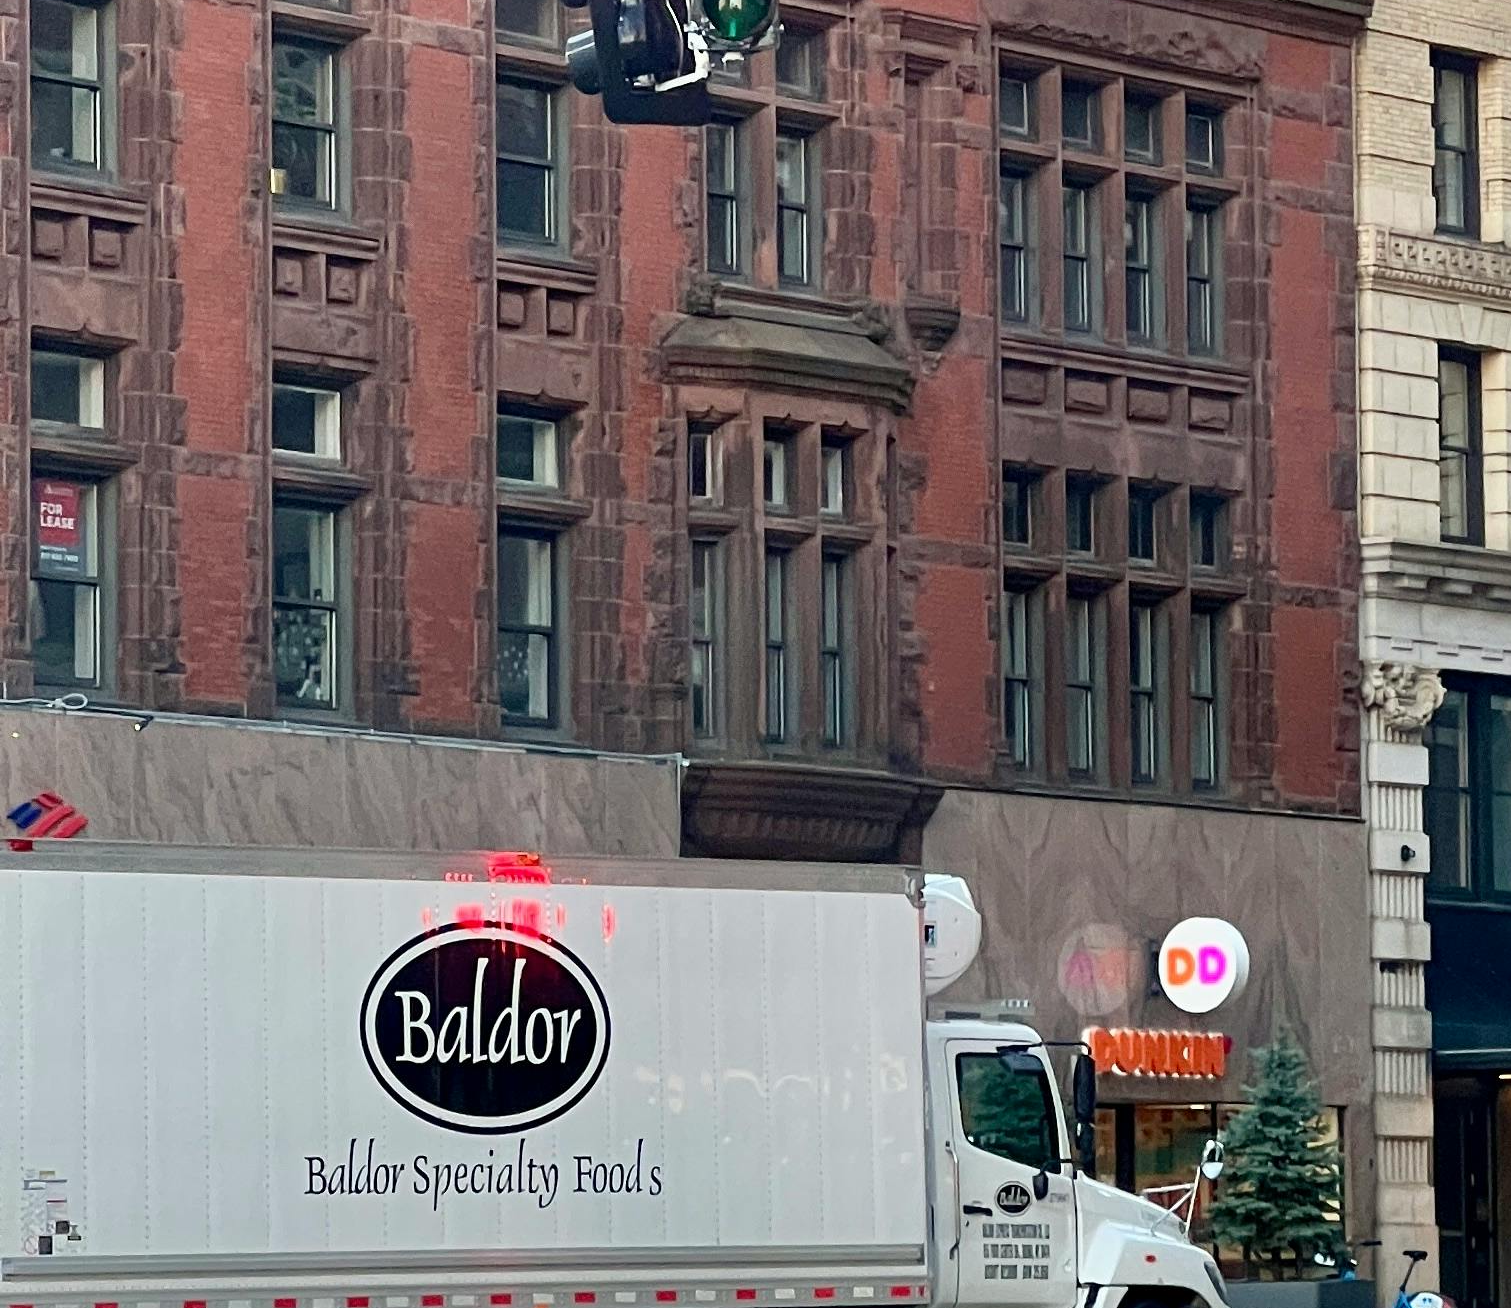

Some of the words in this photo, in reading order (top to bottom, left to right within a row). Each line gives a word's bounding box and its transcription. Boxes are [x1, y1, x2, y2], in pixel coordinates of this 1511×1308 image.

[40, 502, 63, 516] FOR
[40, 515, 76, 530] LEASE
[1166, 945, 1227, 986] DD
[394, 957, 581, 1065] Baldor
[304, 1138, 405, 1195] Baldor
[413, 1138, 559, 1211] Specialty
[573, 1138, 663, 1196] Foods
